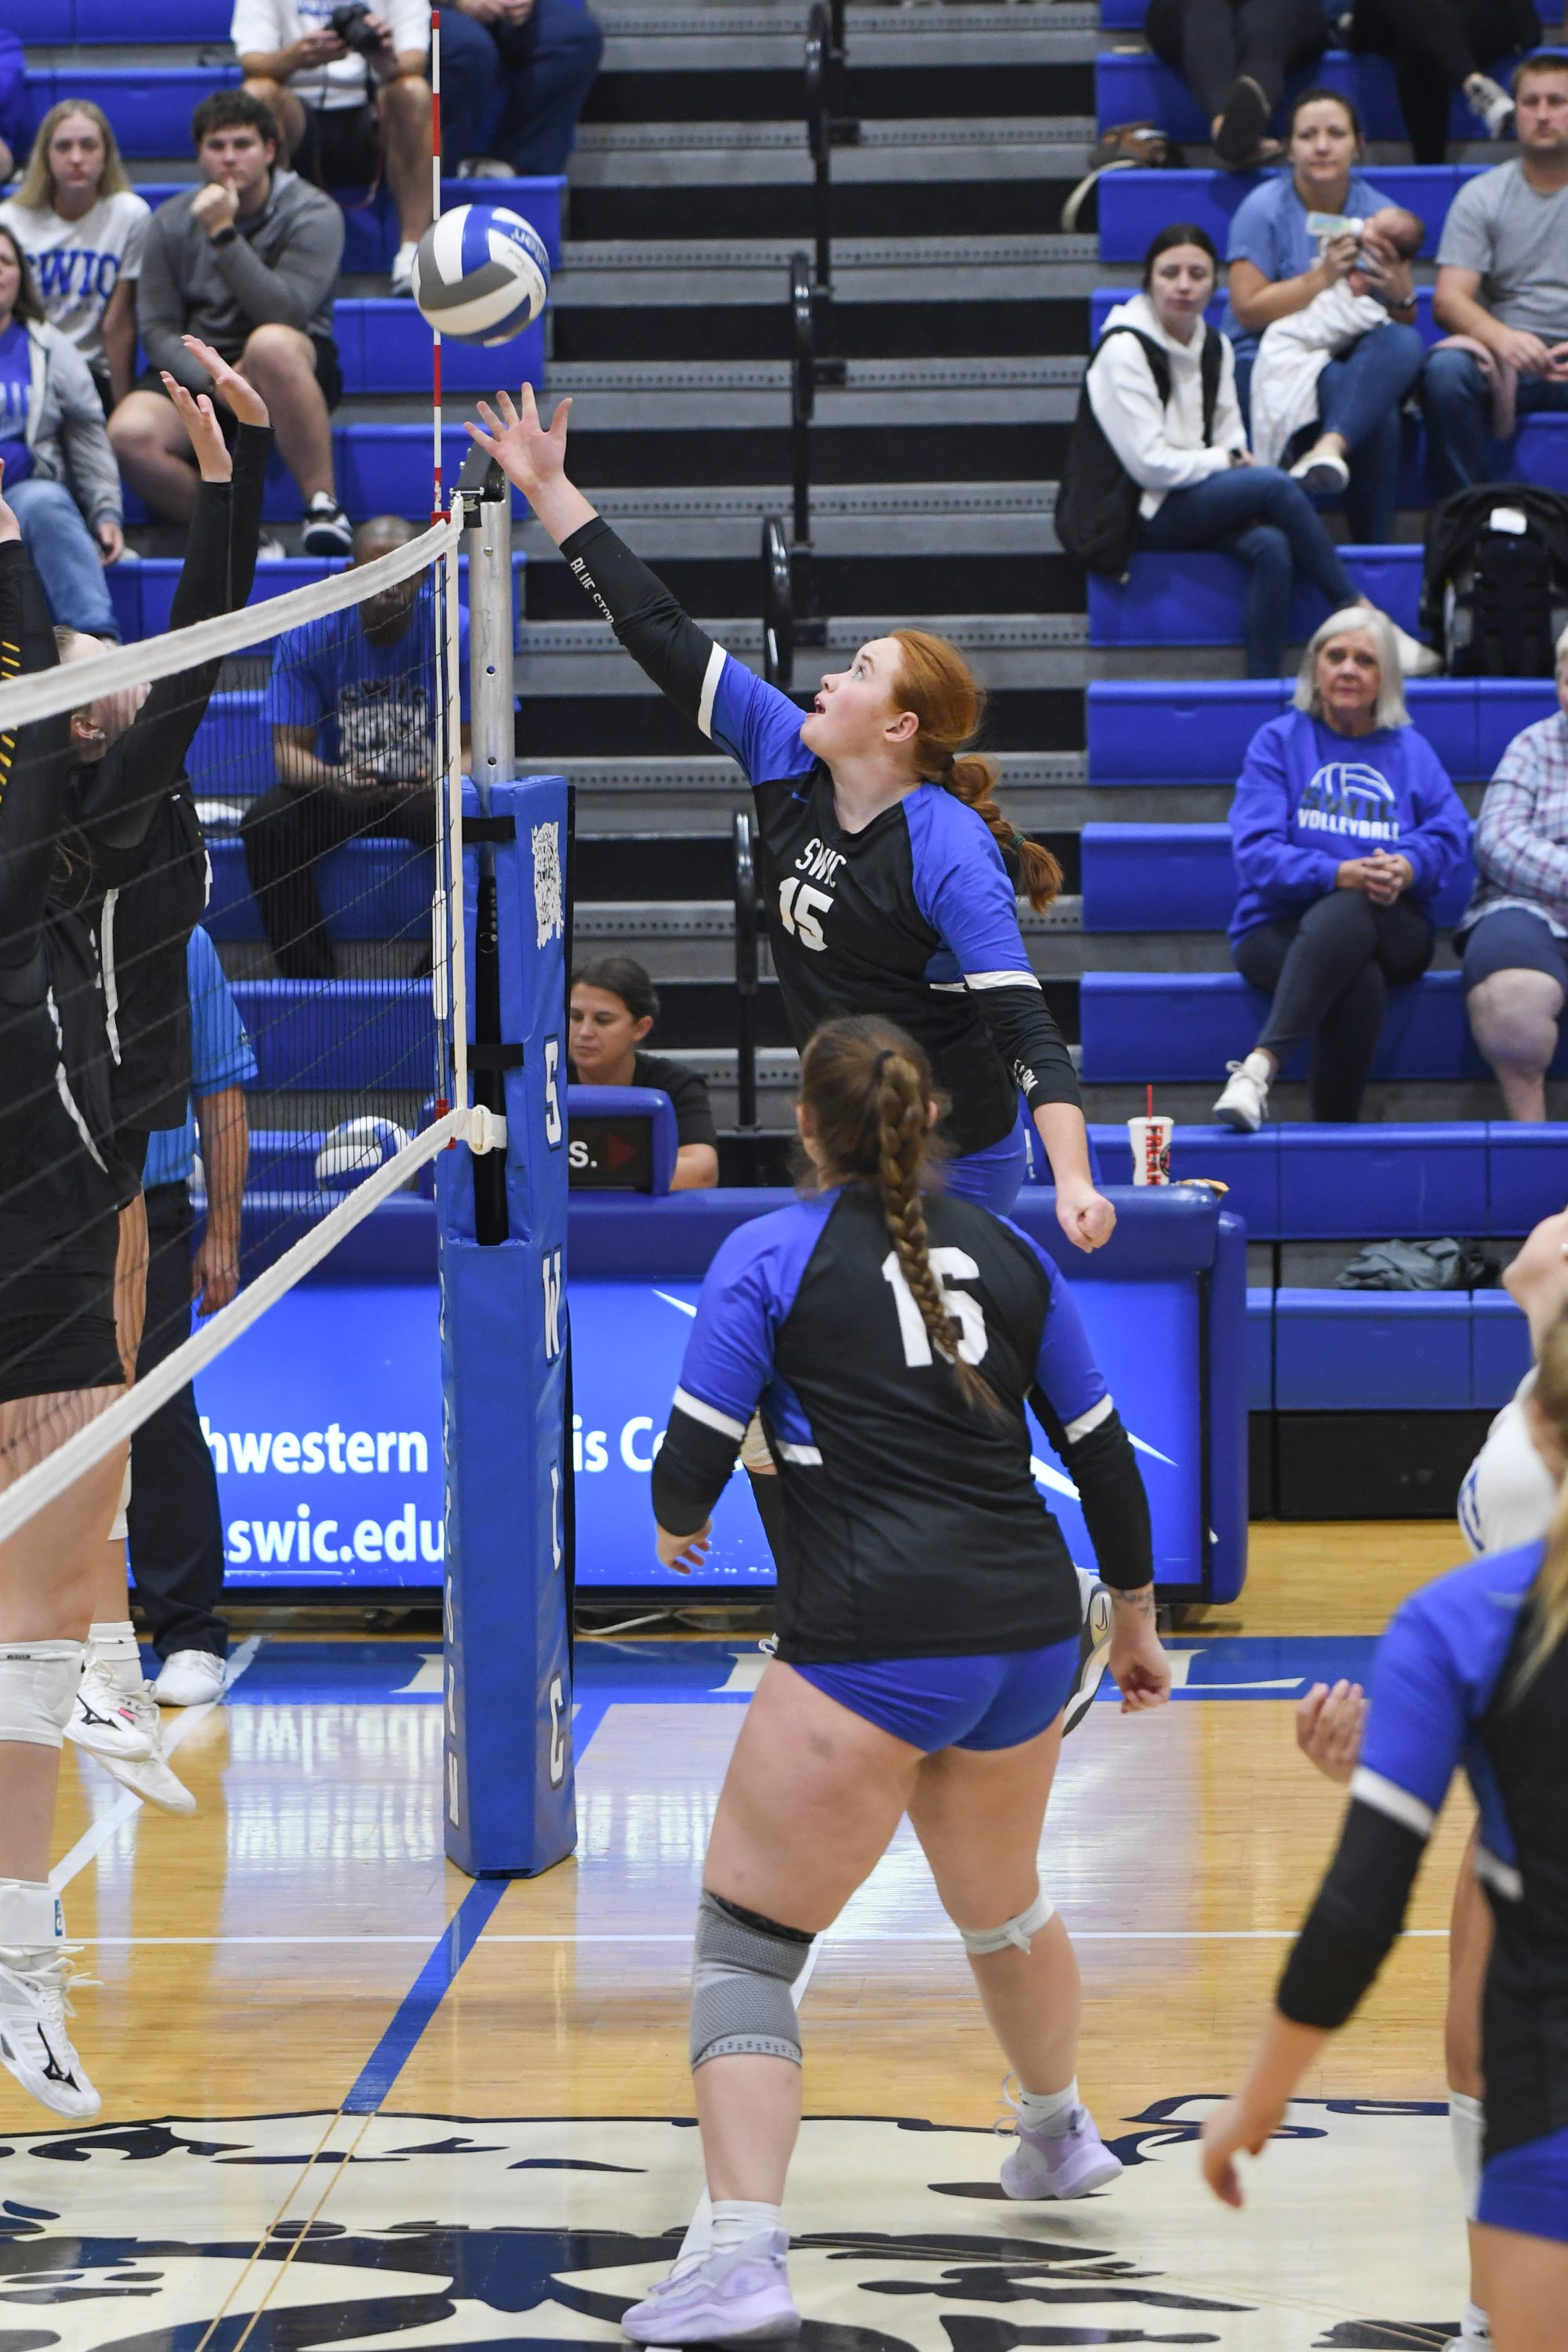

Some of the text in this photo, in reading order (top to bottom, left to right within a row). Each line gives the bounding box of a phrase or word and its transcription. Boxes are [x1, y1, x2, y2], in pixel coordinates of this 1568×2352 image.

[25, 249, 121, 299] WIC
[1298, 808, 1399, 842] VOLLEYBALL
[778, 876, 835, 952] 15
